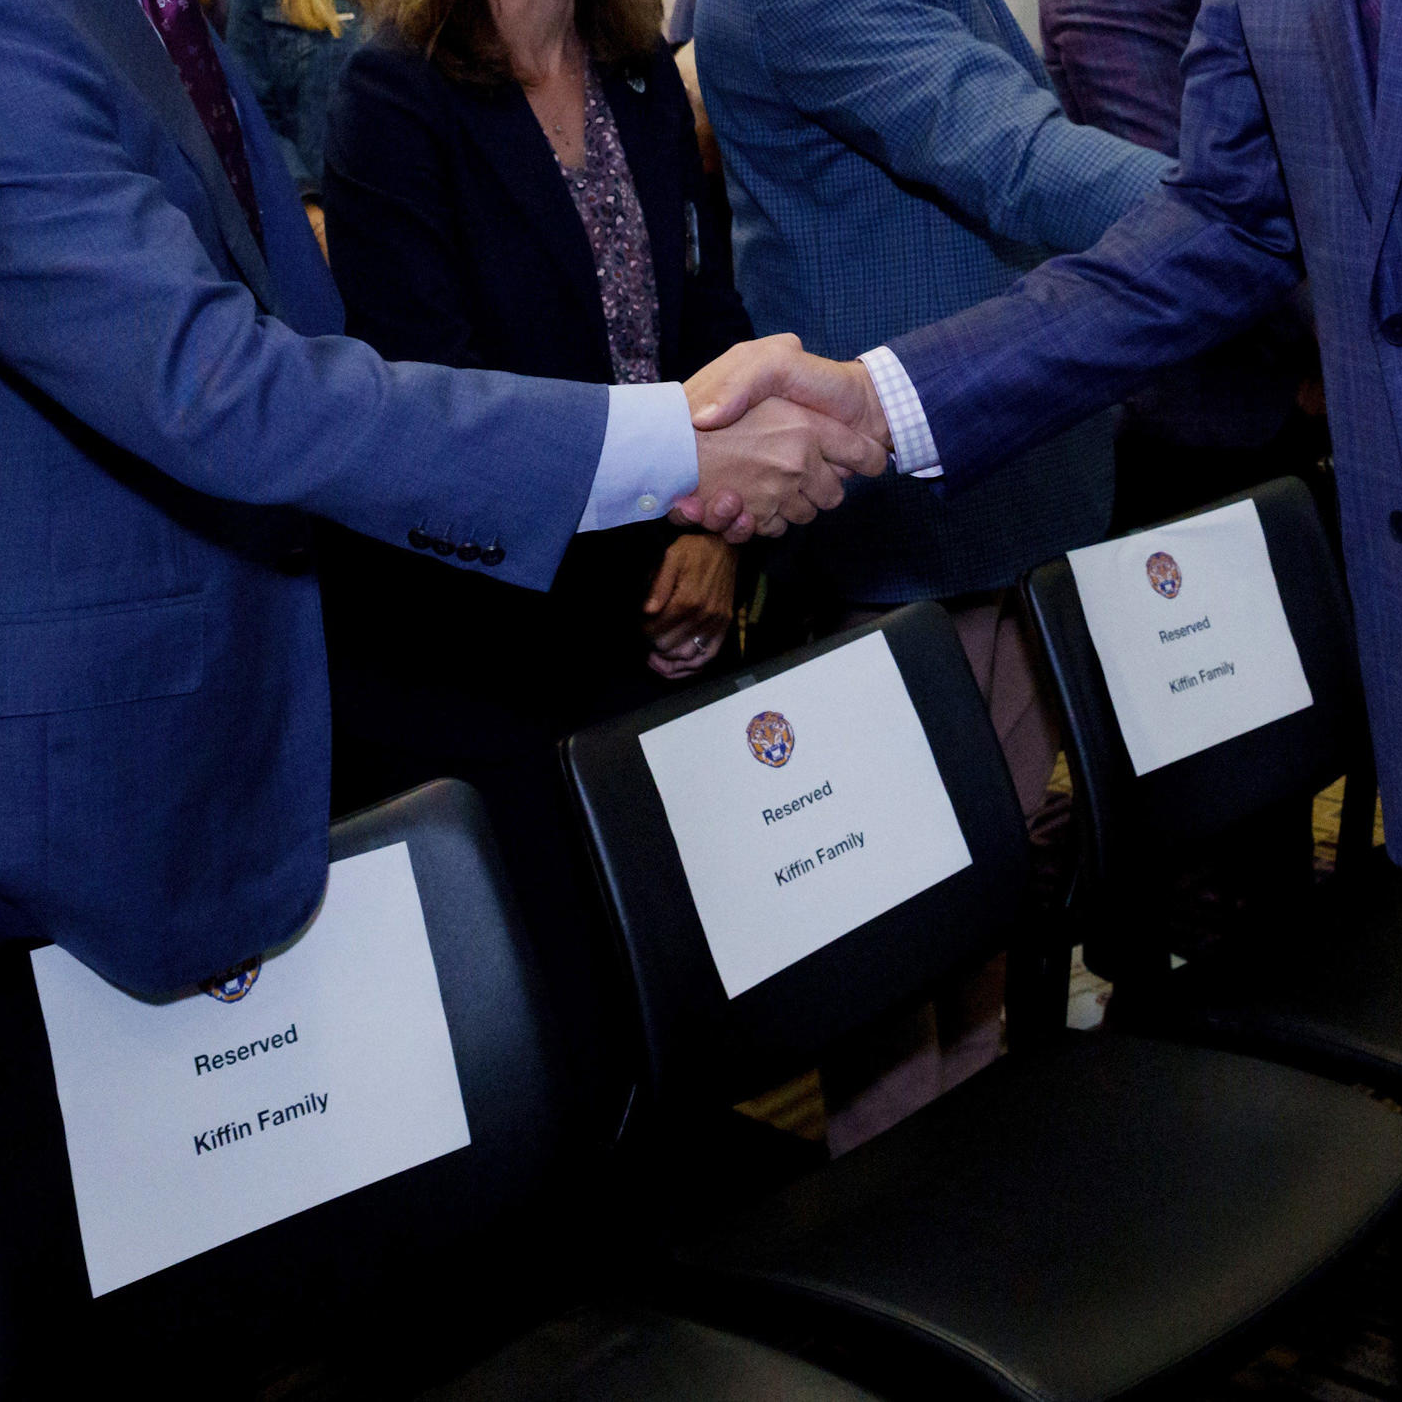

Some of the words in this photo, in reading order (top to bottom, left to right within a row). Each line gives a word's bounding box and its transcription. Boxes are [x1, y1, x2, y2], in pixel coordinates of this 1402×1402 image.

[1158, 614, 1211, 645] Reserved
[1168, 675, 1199, 695] Kiffin
[1198, 661, 1236, 684] Family
[761, 780, 834, 826] Reserved
[774, 858, 816, 887] Kiffin
[815, 831, 865, 865] Family
[193, 1023, 299, 1076] Reserved
[193, 1122, 253, 1156] Kiffin
[256, 1092, 329, 1132] Family
